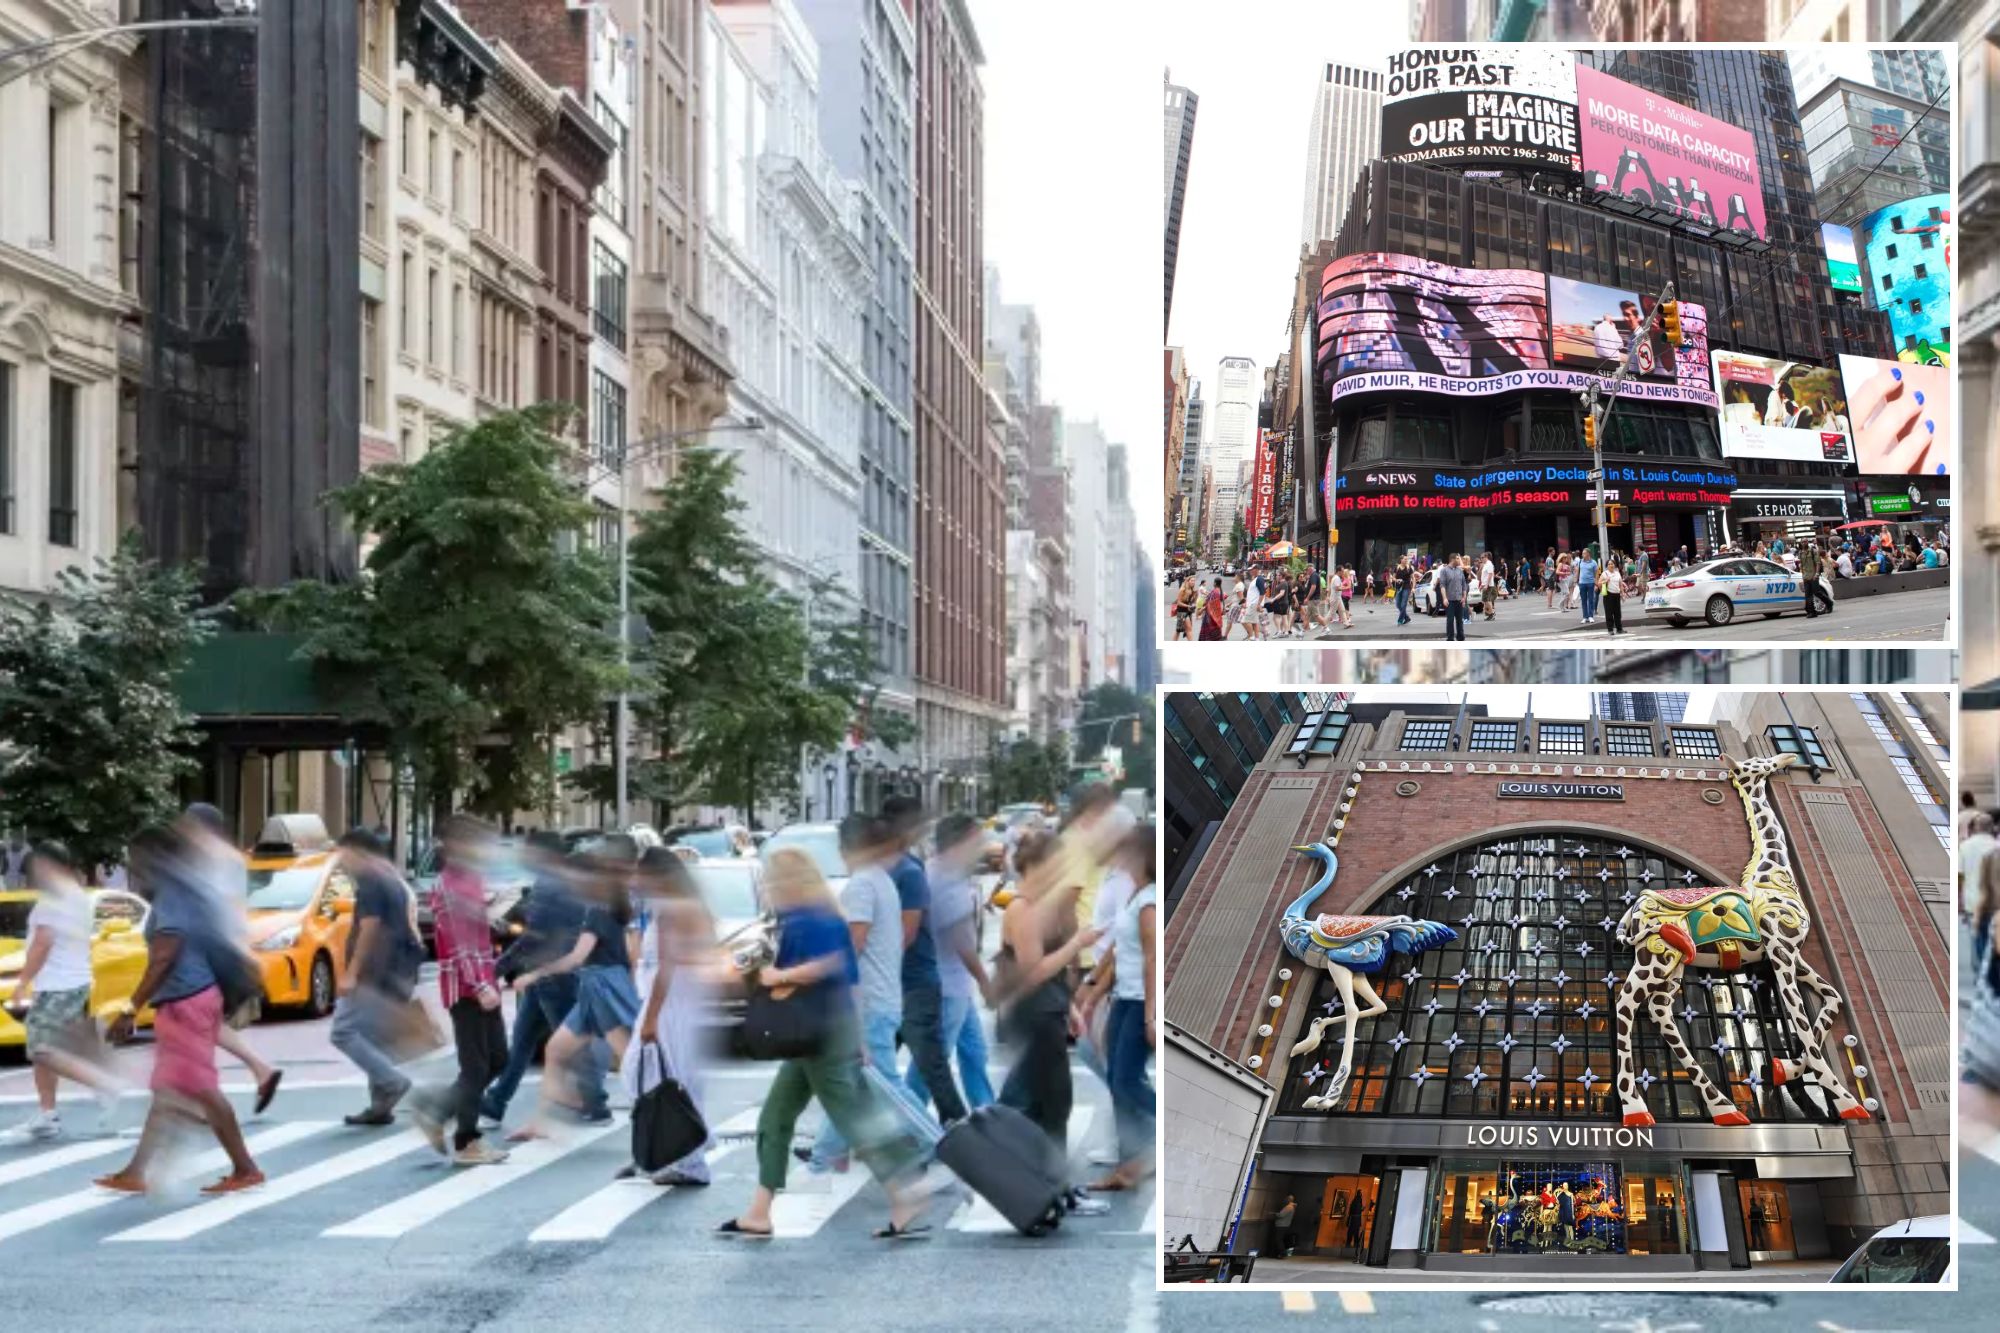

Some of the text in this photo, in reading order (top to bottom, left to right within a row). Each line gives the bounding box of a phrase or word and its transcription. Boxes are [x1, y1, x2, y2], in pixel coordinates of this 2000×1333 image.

[1387, 50, 1477, 75] HONOR
[1387, 65, 1514, 96] OUR PAST
[1468, 93, 1574, 128] IMAGINE
[1409, 117, 1576, 152] OUR FUTURE
[1588, 97, 1751, 172] MORE DATA CAPACITY
[1467, 146, 1480, 156] 50
[1482, 146, 1510, 156] NYC
[1513, 149, 1537, 159] 1965
[1546, 152, 1570, 165] 2015
[1591, 117, 1754, 185] PER CUSTOMER THAN VERIZON
[1336, 376, 1366, 395] DAVID
[1370, 374, 1414, 389] MUIR,
[1418, 375, 1437, 388] HE
[1441, 378, 1503, 393] REPORTS
[1506, 373, 1523, 387] TO
[1527, 372, 1562, 385] YOU.
[1647, 387, 1680, 398] NEWS
[1681, 388, 1715, 403] TONIGHT
[1378, 473, 1416, 485] NEWS
[1434, 474, 1466, 488] State
[1470, 474, 1483, 488] of
[1609, 468, 1620, 480] in
[1622, 468, 1638, 481] St.
[1641, 468, 1669, 482] Louis
[1672, 470, 1706, 486] County
[1707, 472, 1723, 484] Due
[1357, 494, 1399, 509] Smith
[1404, 495, 1418, 507] to
[1422, 495, 1456, 509] retire
[1459, 496, 1490, 509] after
[1515, 490, 1569, 503] season
[1632, 488, 1665, 503] Agent
[1667, 491, 1697, 502] warns
[1765, 582, 1796, 594] NYPD
[1501, 783, 1622, 795] LOUIS VUITTON
[1468, 1125, 1654, 1148] LOUIS VUITTON
